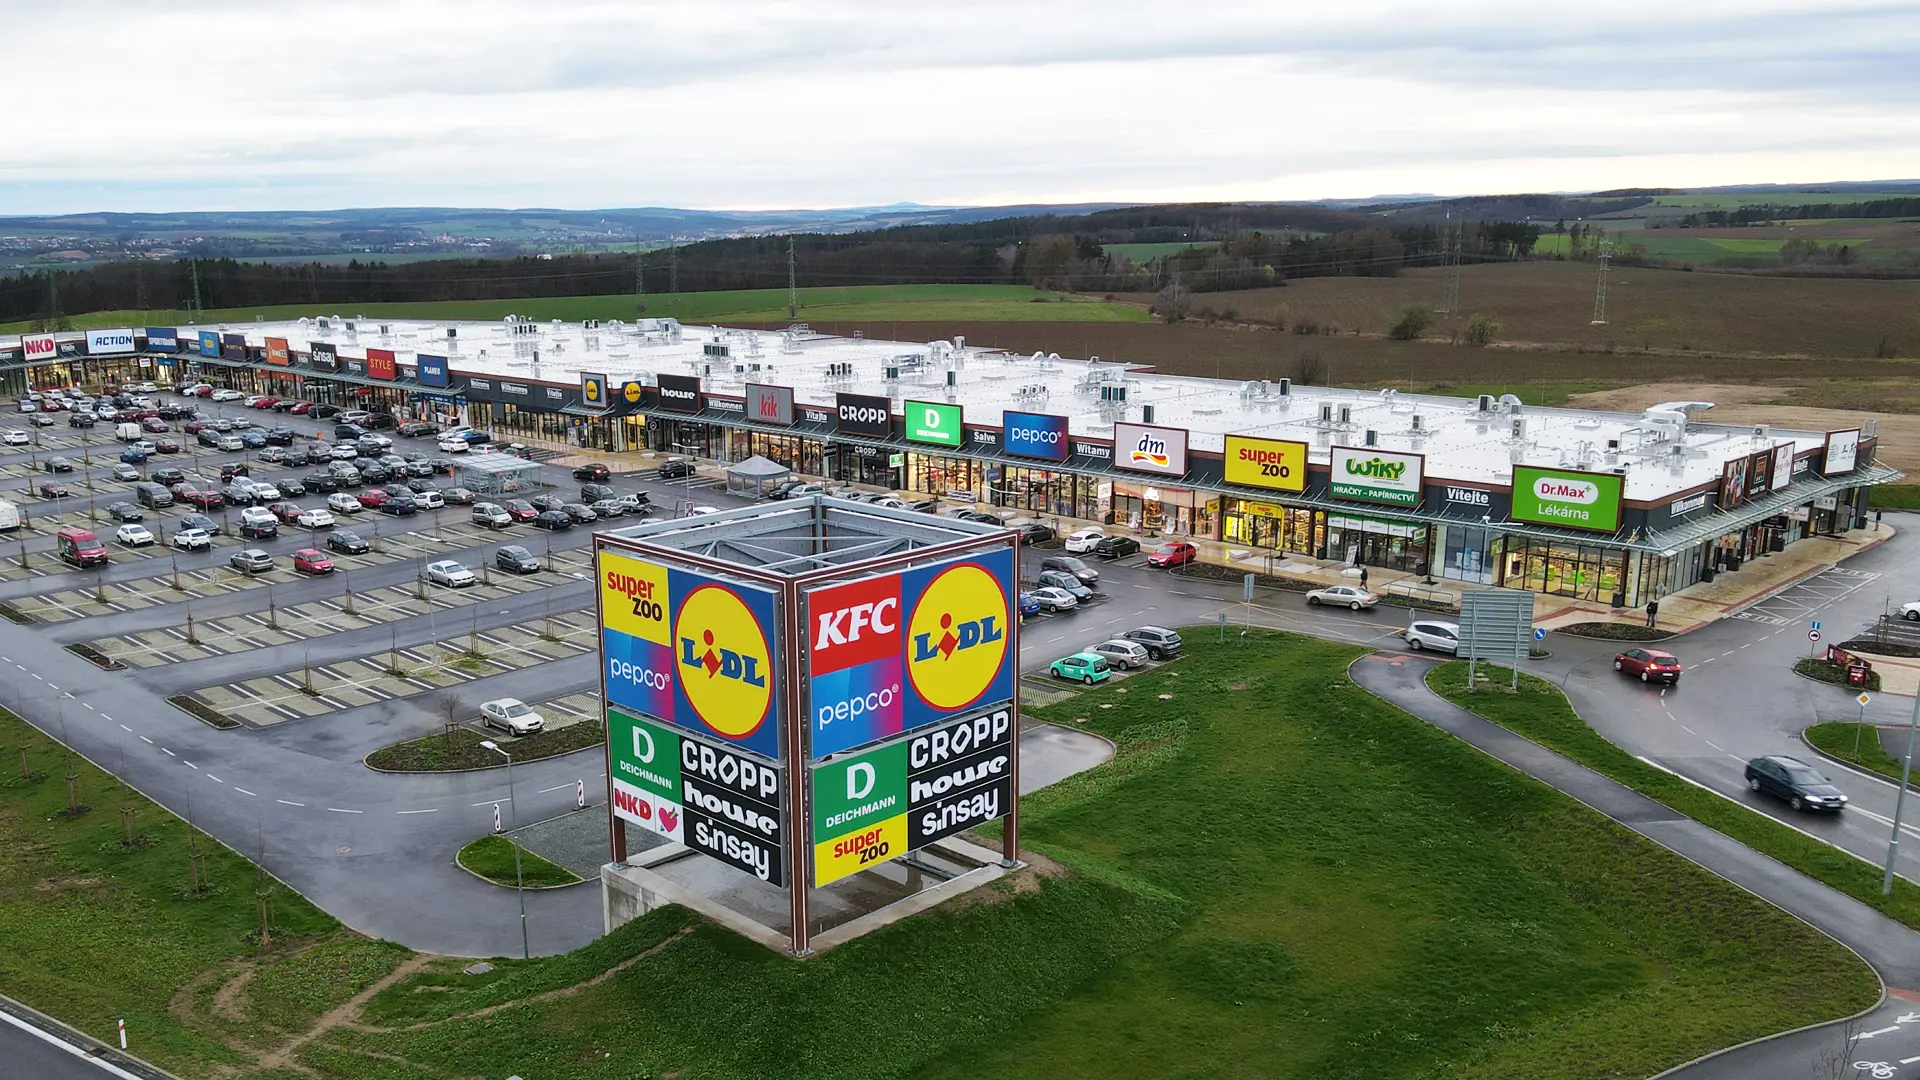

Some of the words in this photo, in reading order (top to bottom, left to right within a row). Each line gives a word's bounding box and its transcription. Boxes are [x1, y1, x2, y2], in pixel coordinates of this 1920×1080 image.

[25, 338, 55, 355] NKD
[95, 336, 133, 346] ACTION
[312, 347, 336, 368] sinsay
[370, 358, 393, 370] STYLE
[661, 387, 696, 400] house
[708, 398, 743, 411] Willkommen
[759, 391, 778, 417] kik
[839, 405, 887, 424] CROPP
[925, 408, 940, 429] D
[973, 431, 996, 443] Salve
[1138, 434, 1165, 455] dm
[854, 445, 877, 456] CROPP
[1077, 443, 1111, 457] Witamy
[1239, 447, 1284, 465] super
[1261, 463, 1290, 478] zoo
[1333, 485, 1362, 497] HRAČKY
[1368, 488, 1415, 503] PAPÍRNICTVÍ
[1447, 487, 1489, 505] Vítejte
[1538, 502, 1590, 520] Lékárna
[607, 571, 655, 600] super
[632, 597, 663, 622] zoo
[814, 597, 897, 651] KFC
[632, 725, 655, 764] D
[911, 710, 1009, 770] CROPP
[619, 760, 673, 790] DEICHMANN
[681, 738, 778, 800] CROPP
[911, 754, 1008, 804] house
[846, 761, 876, 801] D
[614, 787, 652, 821] NKD
[684, 780, 779, 836] house
[825, 795, 896, 829] DEICHMANN
[921, 788, 999, 836] sinsay
[695, 818, 770, 882] sinsay
[833, 828, 883, 859] super
[858, 841, 890, 866] zoo
